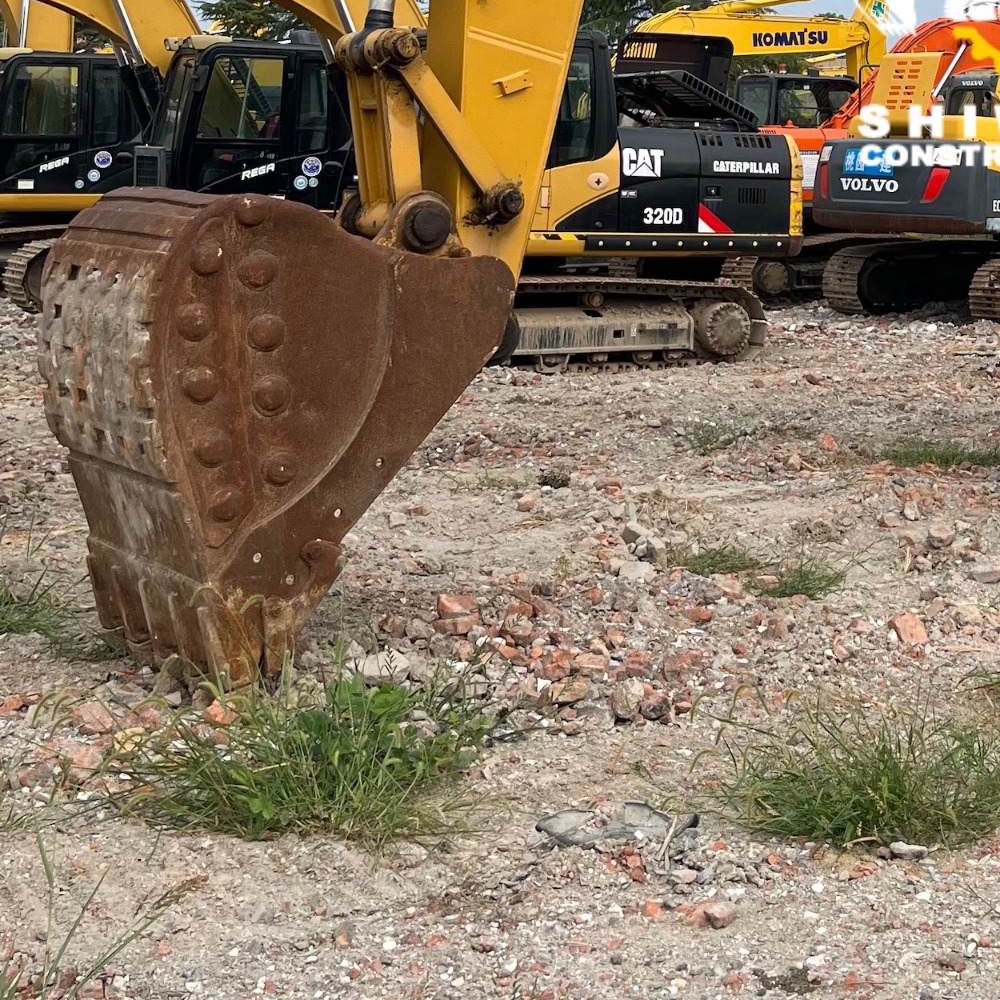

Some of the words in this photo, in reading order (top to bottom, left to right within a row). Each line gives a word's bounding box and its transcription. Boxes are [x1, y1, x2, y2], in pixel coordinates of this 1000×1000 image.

[752, 28, 828, 47] KOMATSU
[39, 157, 70, 173] REGA
[241, 163, 276, 181] REGA
[622, 148, 665, 178] CAT
[713, 160, 780, 174] CATERPILLAR
[840, 178, 899, 193] VOLVO
[643, 207, 683, 225] 320D
